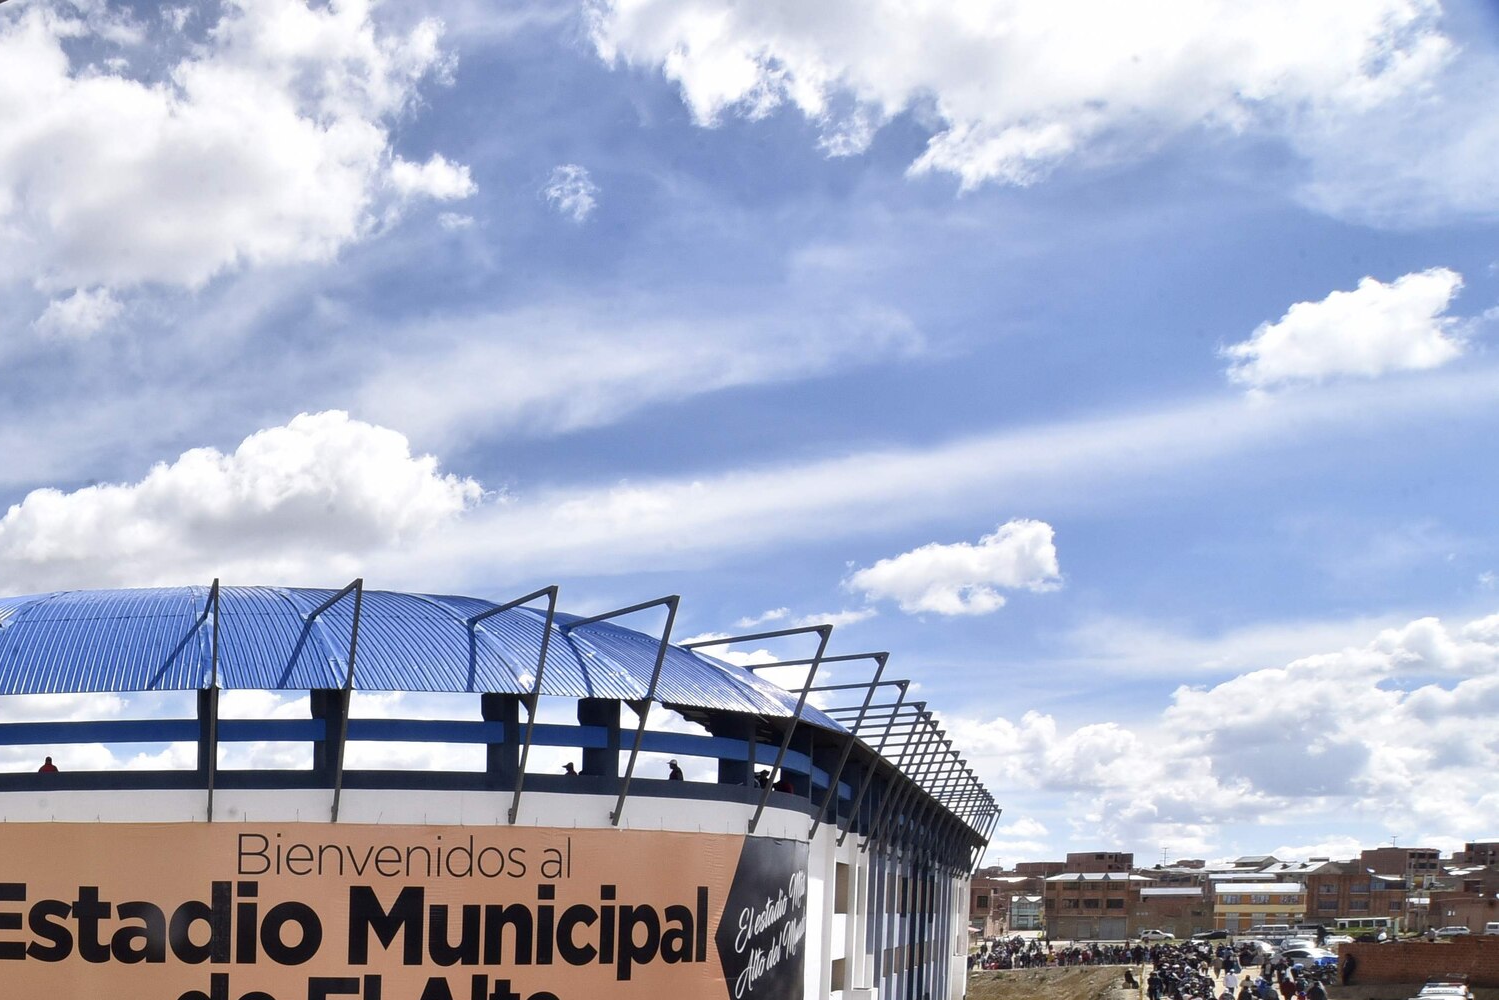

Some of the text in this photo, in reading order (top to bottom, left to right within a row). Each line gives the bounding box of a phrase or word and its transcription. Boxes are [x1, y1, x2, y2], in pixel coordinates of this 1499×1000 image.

[237, 833, 572, 880] Bienvenidos al
[349, 884, 709, 981] Municipal
[754, 888, 788, 935] estadio
[735, 947, 766, 999] Alto
